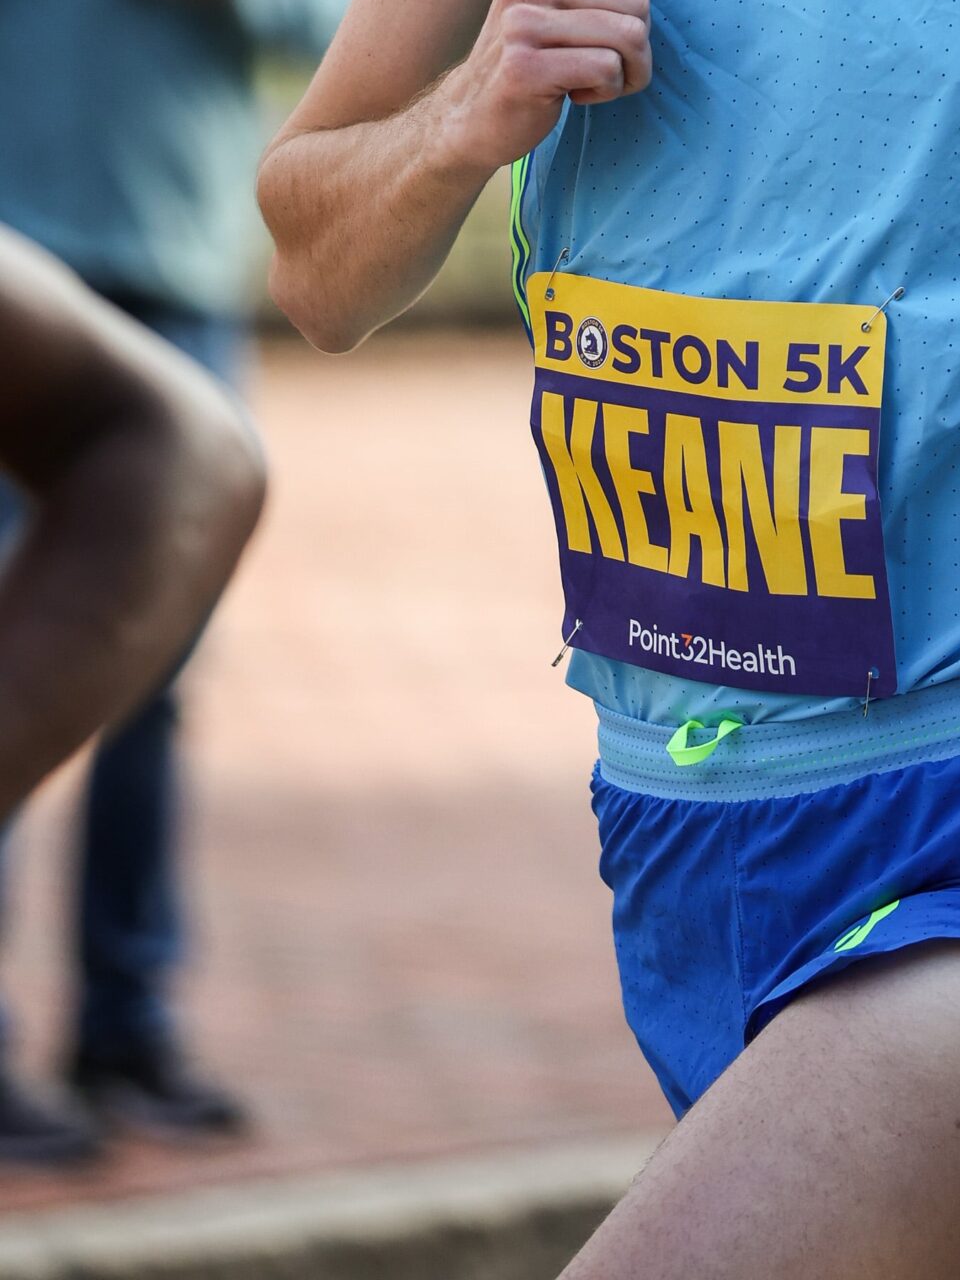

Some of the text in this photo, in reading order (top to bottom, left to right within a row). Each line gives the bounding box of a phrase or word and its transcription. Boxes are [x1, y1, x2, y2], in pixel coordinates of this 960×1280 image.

[545, 310, 871, 396] BOSTON 5K
[540, 391, 876, 599] KEANE
[628, 618, 797, 676] Point32Health
